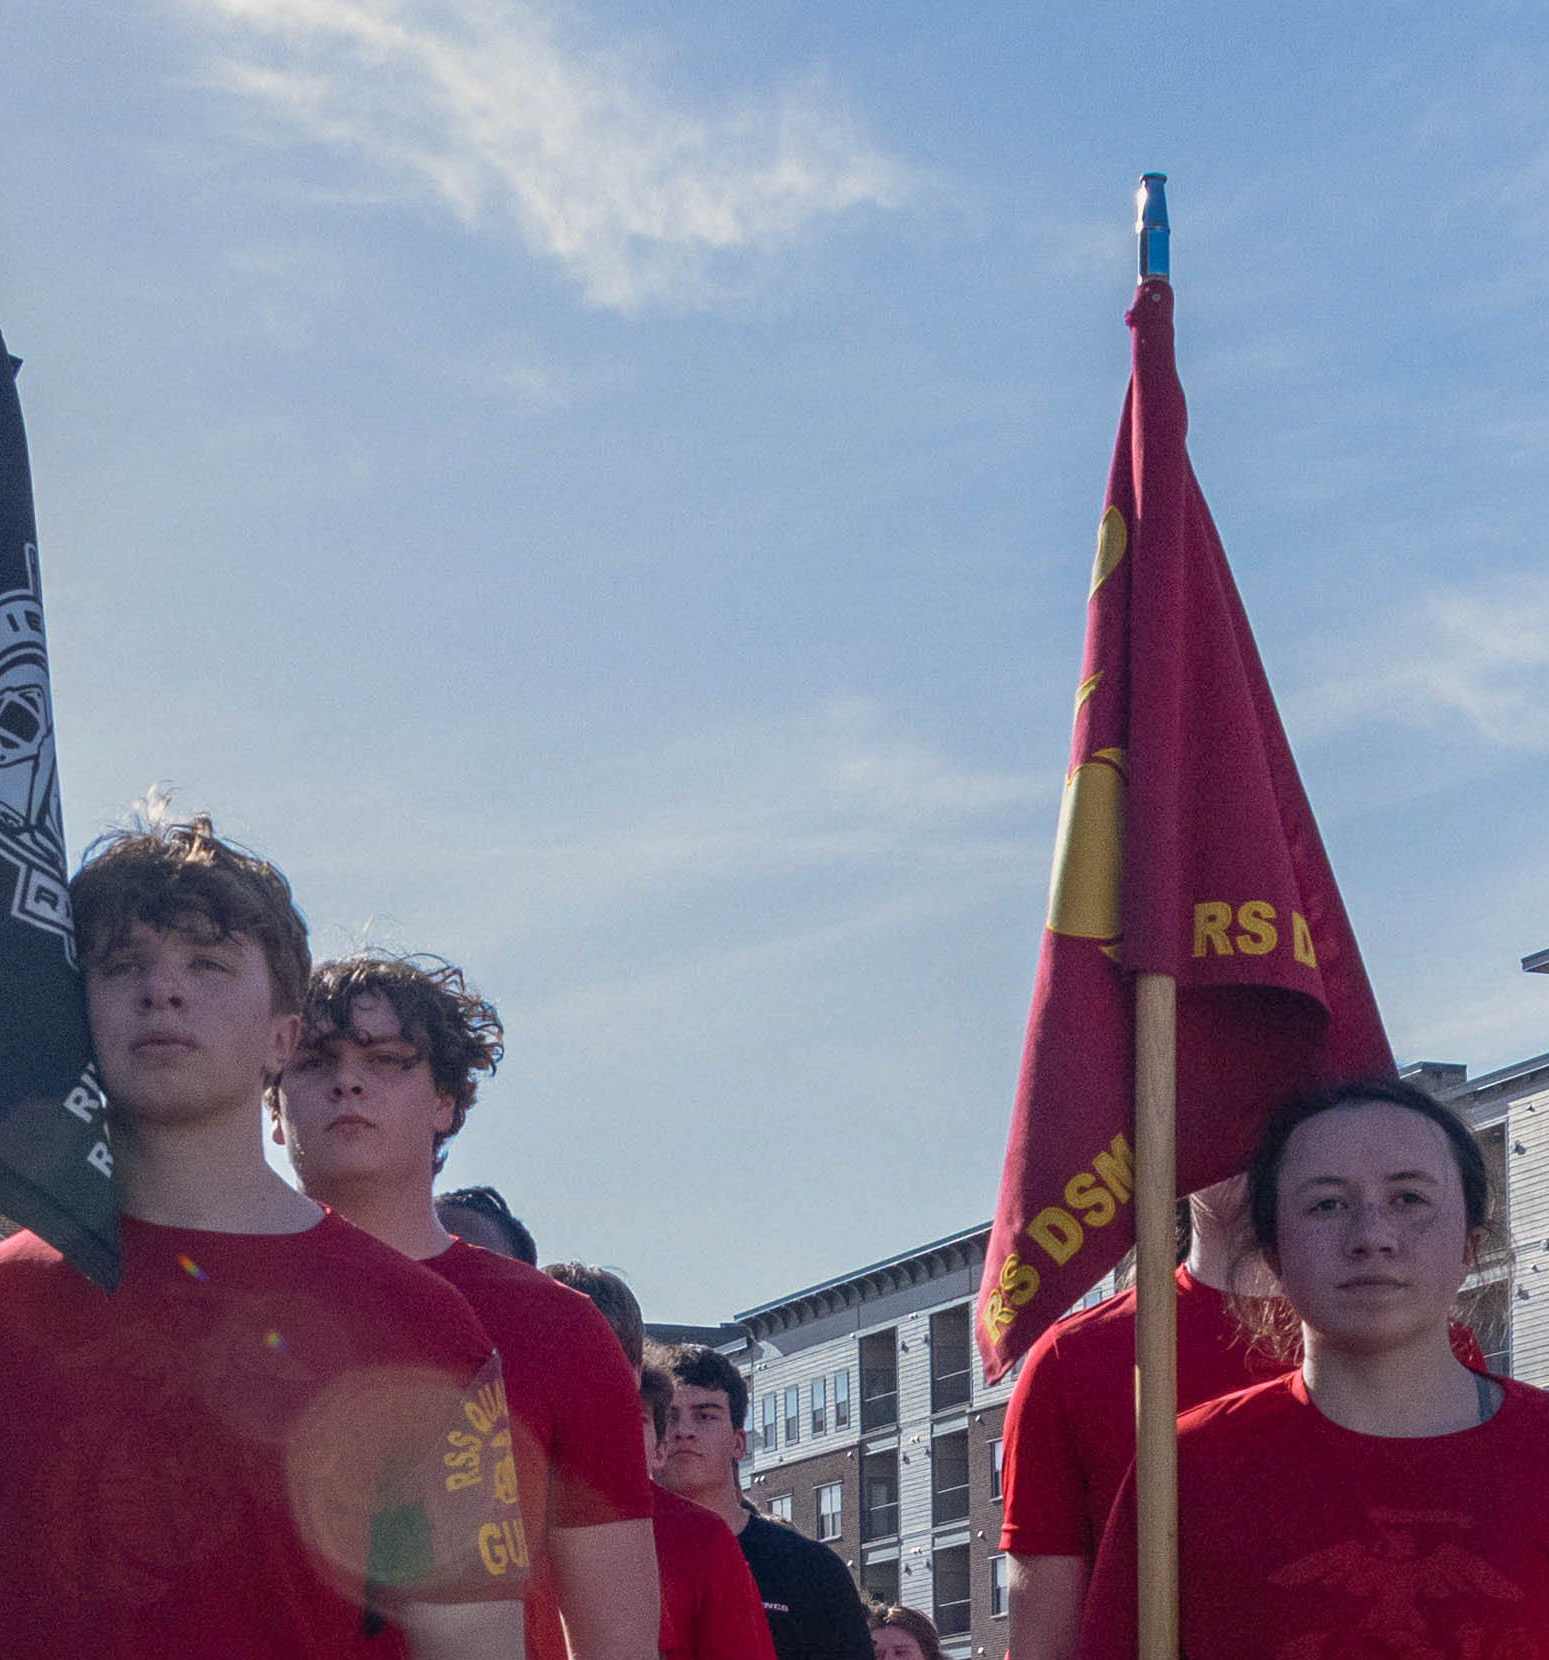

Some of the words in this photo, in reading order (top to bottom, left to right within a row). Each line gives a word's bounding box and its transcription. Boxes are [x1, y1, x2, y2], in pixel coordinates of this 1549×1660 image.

[1192, 900, 1278, 959] RS
[983, 1252, 1041, 1347] RS
[443, 1430, 483, 1493] RSS
[477, 1521, 528, 1576] GU
